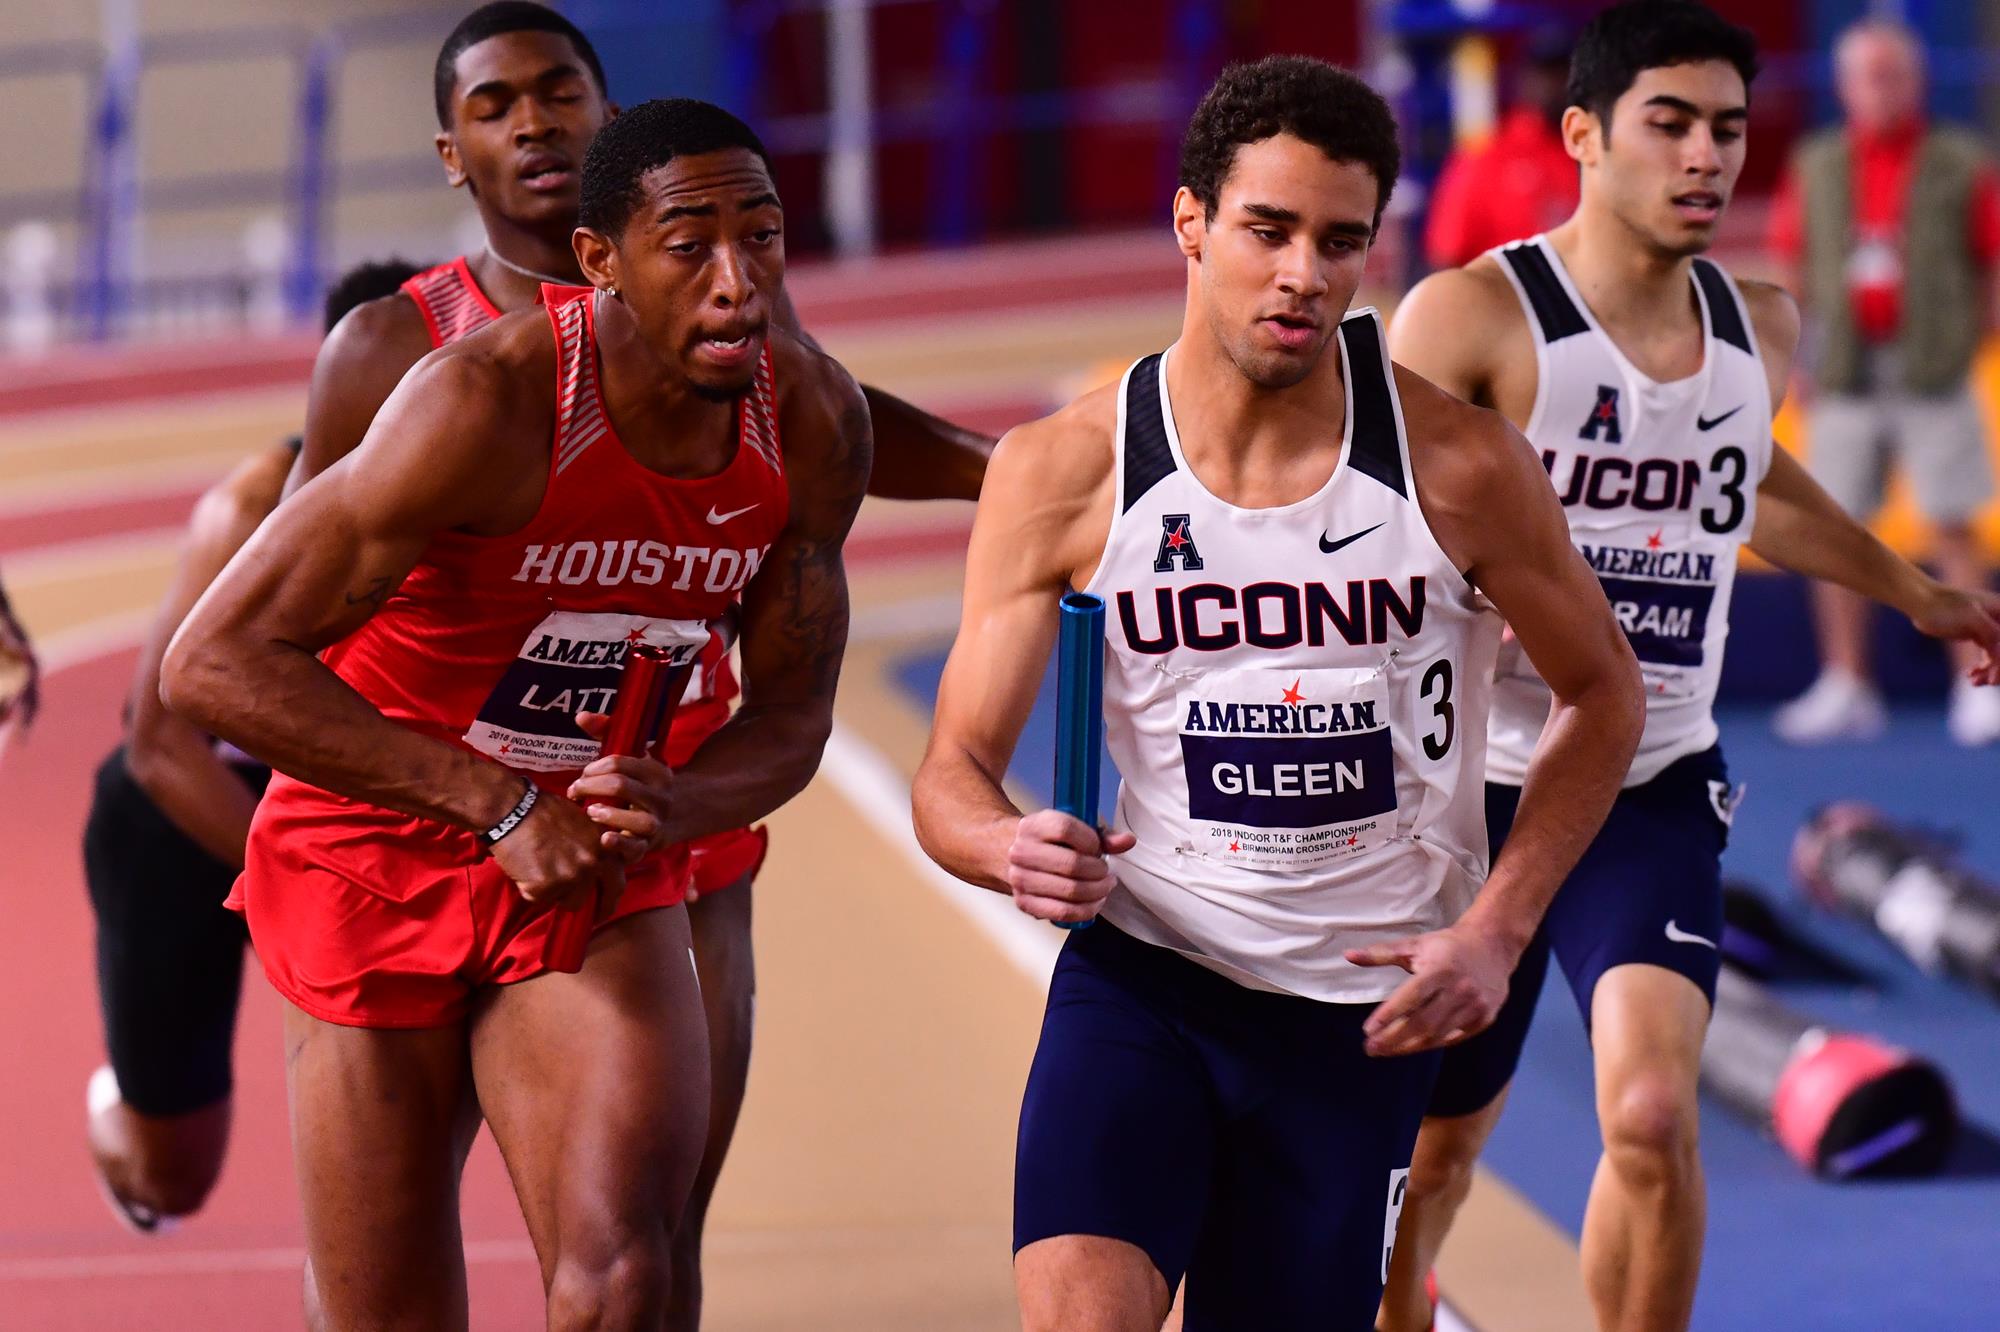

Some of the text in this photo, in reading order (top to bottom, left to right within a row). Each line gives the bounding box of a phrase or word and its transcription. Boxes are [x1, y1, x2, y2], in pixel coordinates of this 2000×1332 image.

[1541, 448, 1701, 511] UCON
[1701, 446, 1747, 534] 3
[510, 539, 771, 593] HOUSTON
[1582, 544, 1715, 582] MERICAN
[1116, 575, 1427, 655] UCONN
[1613, 600, 1694, 638] RAM
[519, 684, 618, 714] LATT
[1184, 700, 1377, 734] AMERICAN
[1419, 658, 1455, 761] 3
[488, 731, 510, 742] 2018
[510, 736, 546, 749] INDOOR
[1211, 759, 1365, 797] GLEEN
[1211, 821, 1377, 844] 2018 INDOOR T&F CHAMPIONSHIPS
[1242, 839, 1346, 854] BIRMINGHAM CROSSPLEX
